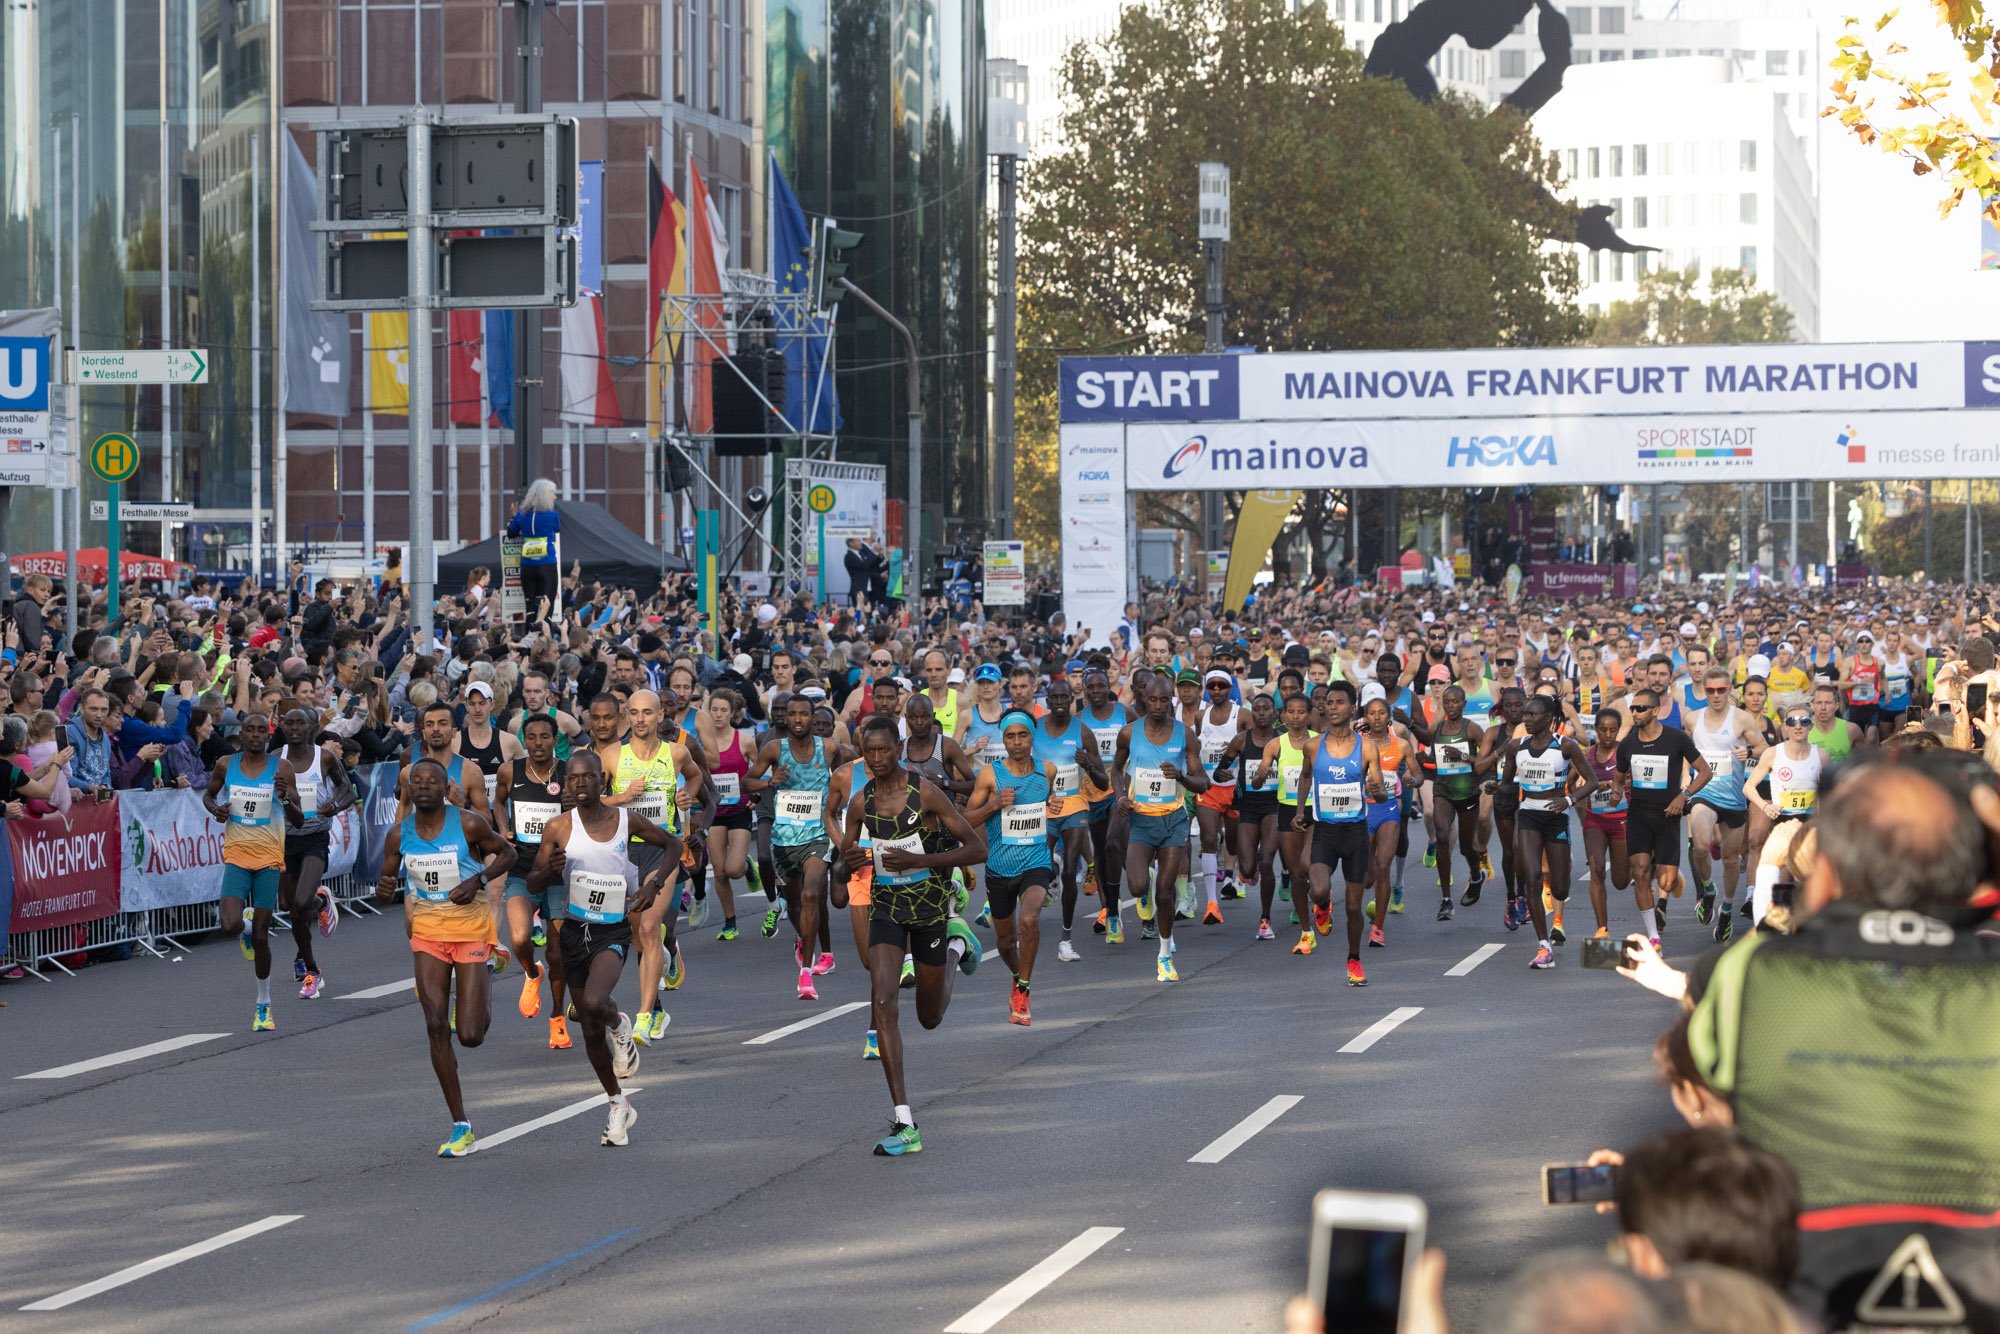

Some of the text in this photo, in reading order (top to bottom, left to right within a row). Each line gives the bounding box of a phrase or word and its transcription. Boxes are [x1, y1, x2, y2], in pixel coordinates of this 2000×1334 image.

[81, 356, 125, 366] Nordend
[95, 369, 138, 379] Westend
[1285, 362, 1918, 399] MAINOVA FRANKFURT MARATHON
[1076, 369, 1219, 408] START
[1637, 427, 1757, 448] SPORTSTADT
[1080, 445, 1118, 454] mainova
[1447, 435, 1558, 468] HOKA
[105, 444, 124, 471] H
[1211, 440, 1369, 470] mainova
[1878, 448, 1945, 463] messe
[1637, 460, 1700, 468] FRANKFURT
[1078, 471, 1110, 480] HOKA
[816, 491, 827, 507] H
[93, 506, 104, 514] 50
[1100, 740, 1111, 750] 42
[1524, 769, 1547, 779] JULIET
[1643, 767, 1654, 777] 38
[1055, 777, 1065, 787] 41
[1149, 781, 1162, 792] 43
[241, 790, 270, 799] mainova
[633, 795, 663, 803] mainova
[1331, 796, 1350, 806] EYOB
[1792, 797, 1806, 808] 5 A
[243, 801, 257, 813] 46
[526, 805, 557, 814] mainova
[786, 803, 813, 814] GEBRU
[1015, 807, 1043, 815] mainova
[524, 821, 547, 835] 959
[1009, 818, 1041, 830] FILIMON
[144, 817, 225, 875] Rosbache
[439, 844, 459, 853] HOKA
[22, 830, 107, 882] MÖVENPICK
[417, 858, 453, 867] mainova
[424, 871, 439, 886] 49
[586, 877, 623, 887] mainova
[892, 876, 912, 884] HOKA
[588, 890, 606, 906] 50
[20, 889, 97, 918] HOTEL FRANKFURT CITY
[584, 911, 604, 921] HOKA
